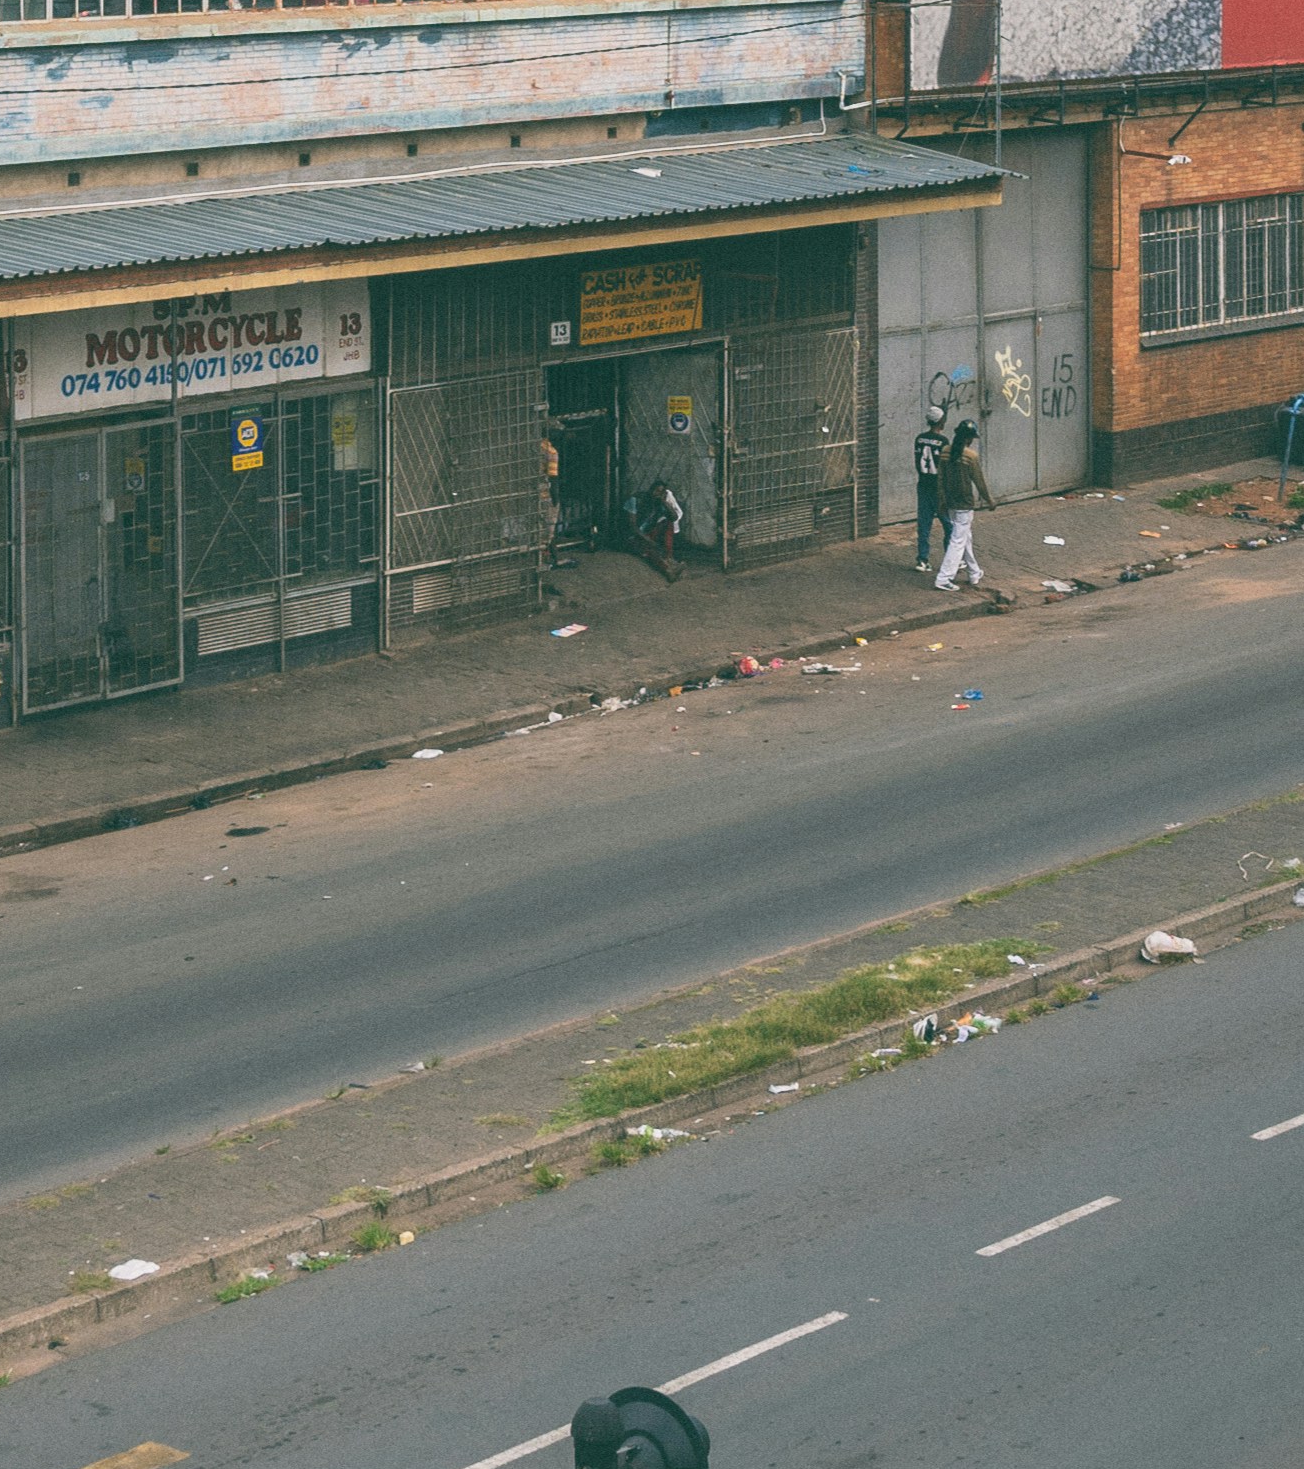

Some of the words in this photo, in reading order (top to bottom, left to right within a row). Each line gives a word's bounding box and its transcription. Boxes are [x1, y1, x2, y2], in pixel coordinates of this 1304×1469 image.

[583, 270, 626, 295] CASH
[85, 308, 303, 368] MOTORCYCLE
[339, 312, 362, 336] 13
[554, 325, 567, 336] 13
[61, 374, 100, 397] 074
[104, 367, 141, 392] 760
[232, 350, 263, 375] 692
[268, 344, 319, 369] 0620
[1052, 354, 1073, 383] 15
[1042, 386, 1076, 419] END
